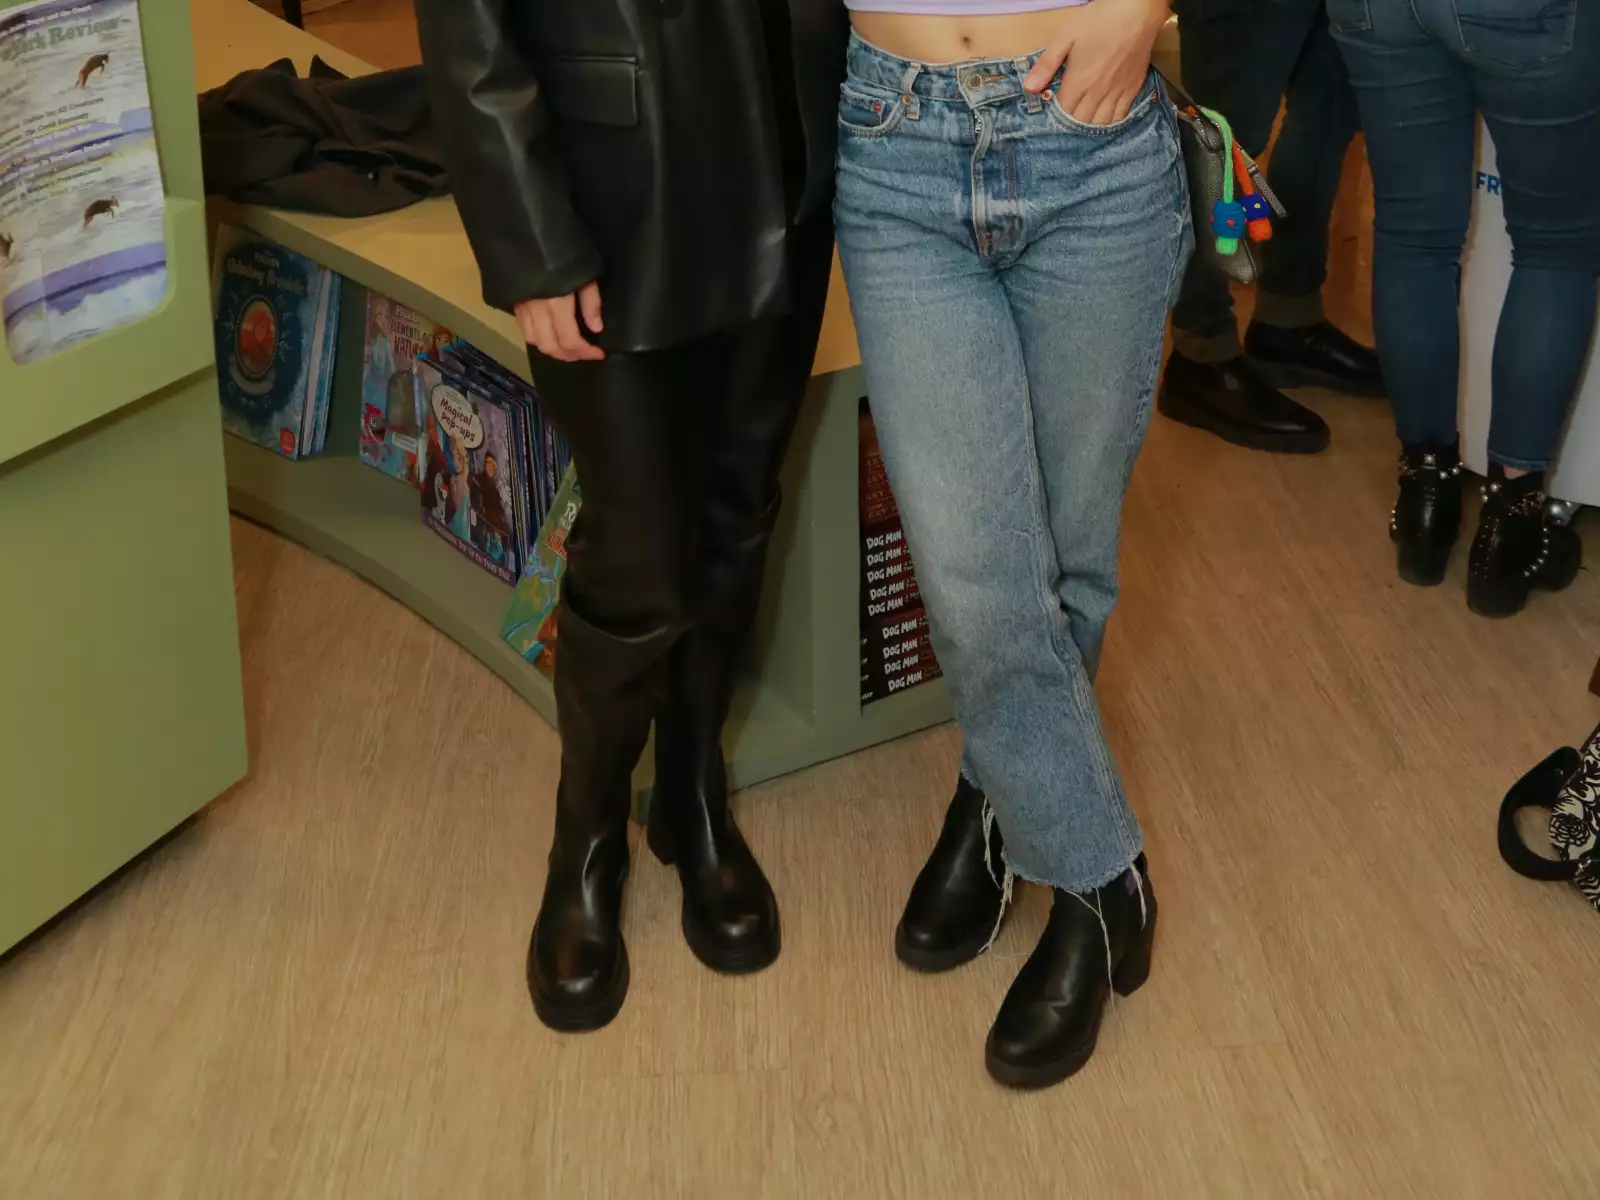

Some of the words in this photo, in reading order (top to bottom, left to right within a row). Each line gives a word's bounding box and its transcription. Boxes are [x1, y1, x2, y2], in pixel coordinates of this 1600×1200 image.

[48, 17, 120, 45] Review
[440, 397, 473, 426] Magical
[441, 411, 476, 442] pop-ups
[866, 535, 884, 550] DOG
[885, 529, 902, 544] MAN
[866, 552, 884, 566] DOG
[885, 546, 902, 561] MAN
[866, 568, 885, 583] DOG
[886, 563, 902, 578] MAN
[869, 586, 887, 600] DOG
[888, 580, 905, 595] MAN
[867, 602, 886, 616] DOG
[887, 596, 903, 611] MAN
[882, 624, 900, 639] DOG
[901, 618, 917, 634] MAN
[882, 644, 900, 659] DOG
[901, 637, 918, 653] MAN
[884, 659, 901, 675] DOG
[902, 654, 919, 669] MAN
[888, 676, 905, 692] DOG
[906, 670, 923, 686] MAN
